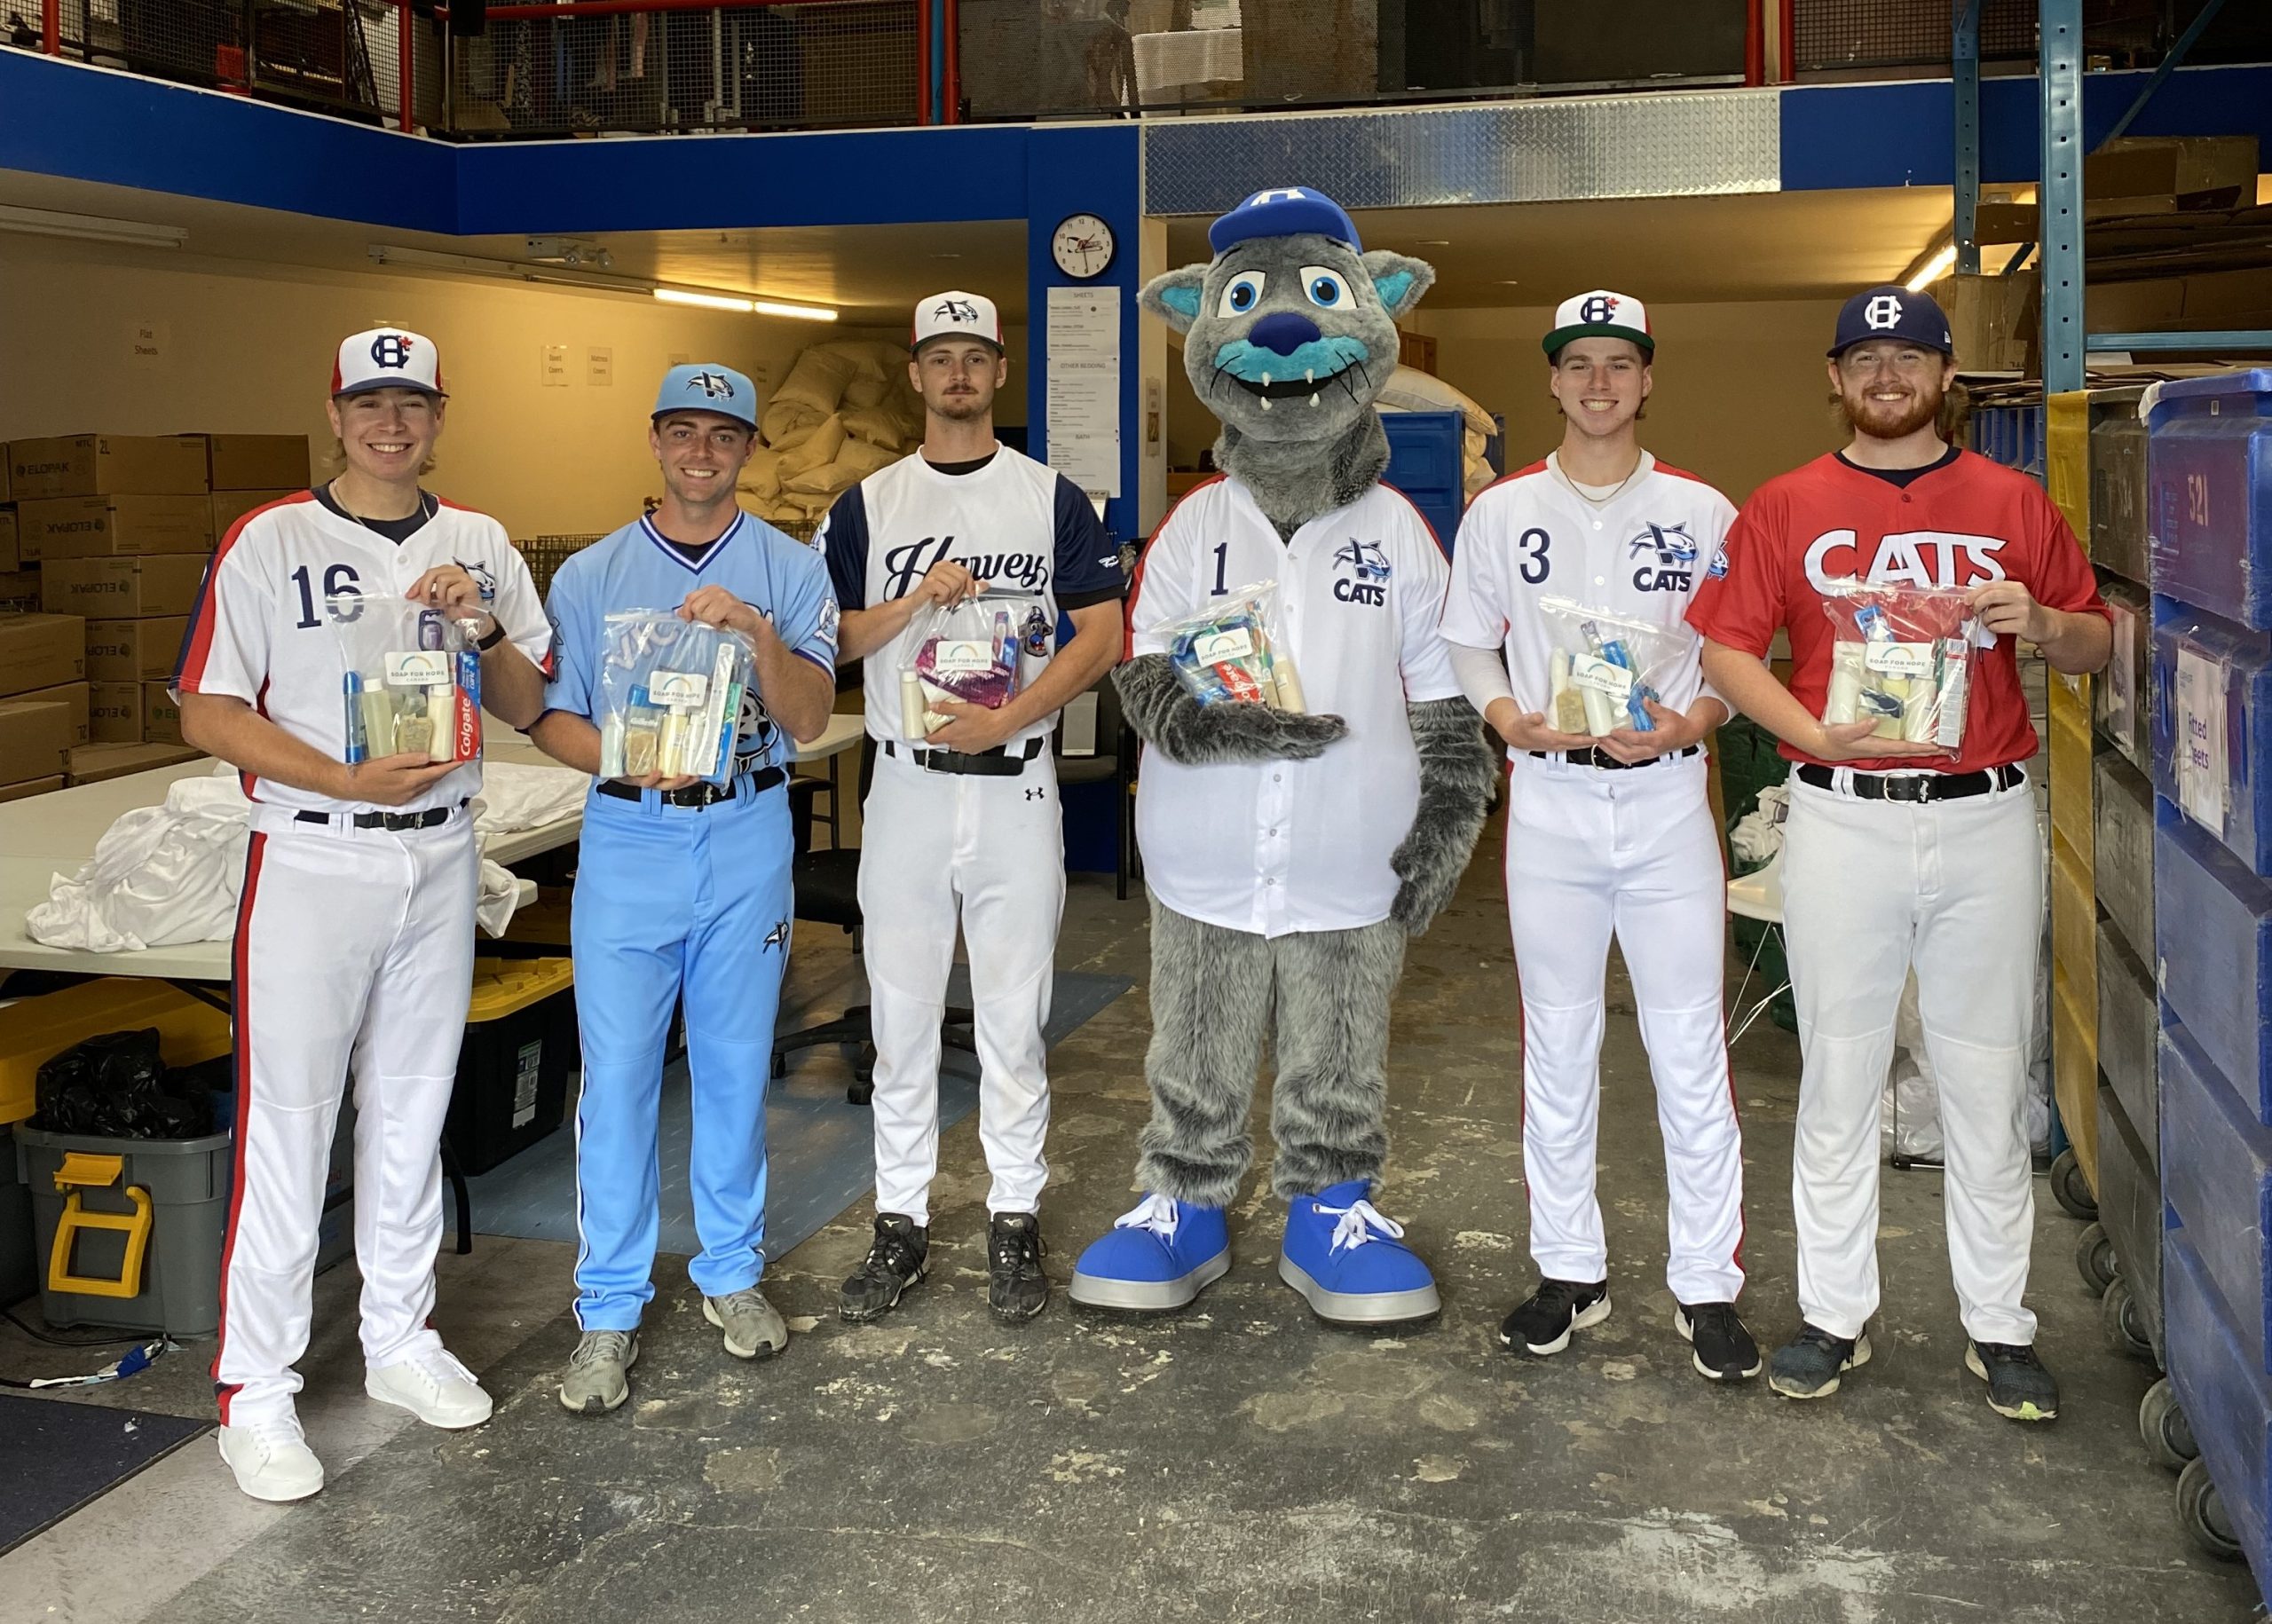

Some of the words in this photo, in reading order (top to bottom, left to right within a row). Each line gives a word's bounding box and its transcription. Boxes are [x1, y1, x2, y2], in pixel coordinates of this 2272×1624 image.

[99, 440, 110, 454] 2L
[28, 462, 69, 475] ELOPAK
[47, 521, 91, 532] ELOPAK
[1211, 542, 1229, 596] 1
[1519, 527, 1550, 584] 3
[1803, 528, 2008, 598] CATS
[71, 582, 116, 594] ELOPAK
[1333, 578, 1386, 607] CATS
[1633, 567, 1692, 592] CATS
[291, 564, 365, 629] 16
[461, 698, 473, 756] Colgate
[2189, 712, 2206, 740] Fitted
[2189, 739, 2208, 769] eets
